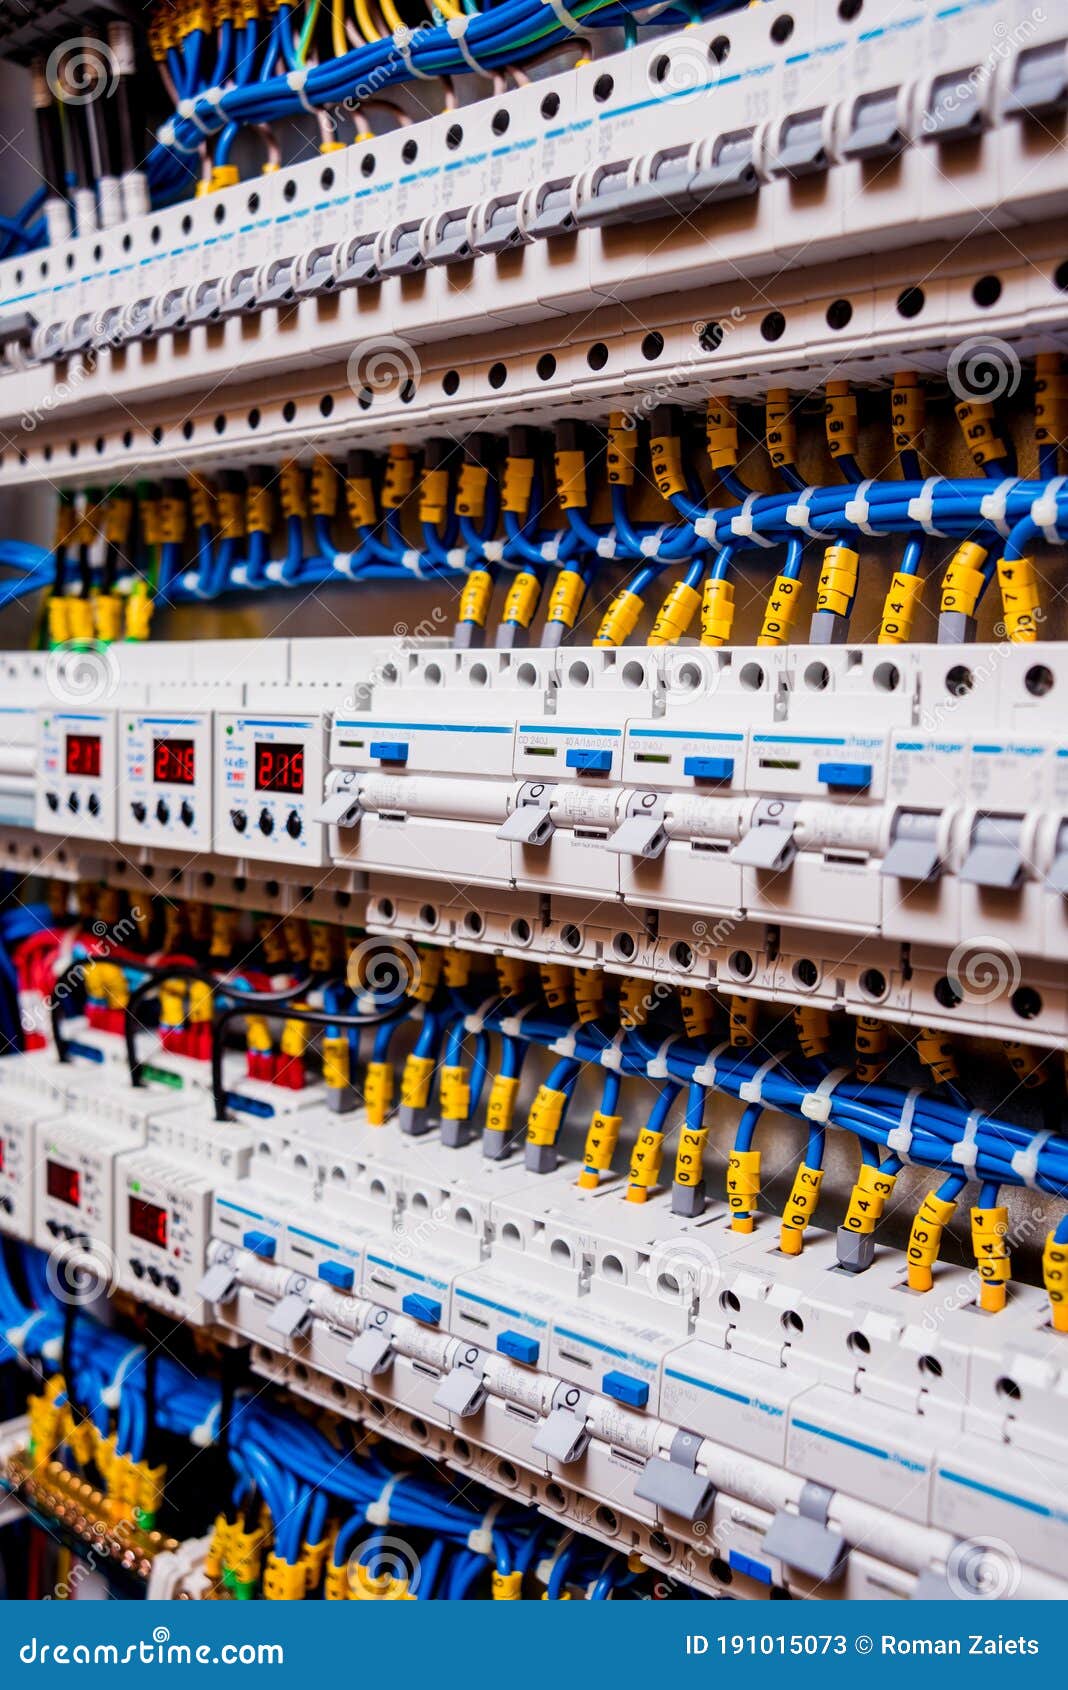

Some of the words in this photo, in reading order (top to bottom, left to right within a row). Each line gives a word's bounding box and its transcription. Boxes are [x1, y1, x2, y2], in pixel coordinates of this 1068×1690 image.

[766, 581, 795, 634] 048
[885, 578, 908, 634] 047
[677, 1133, 702, 1183] 052
[791, 1172, 820, 1227] 052
[849, 1180, 893, 1230] 043
[908, 1200, 939, 1261] 051
